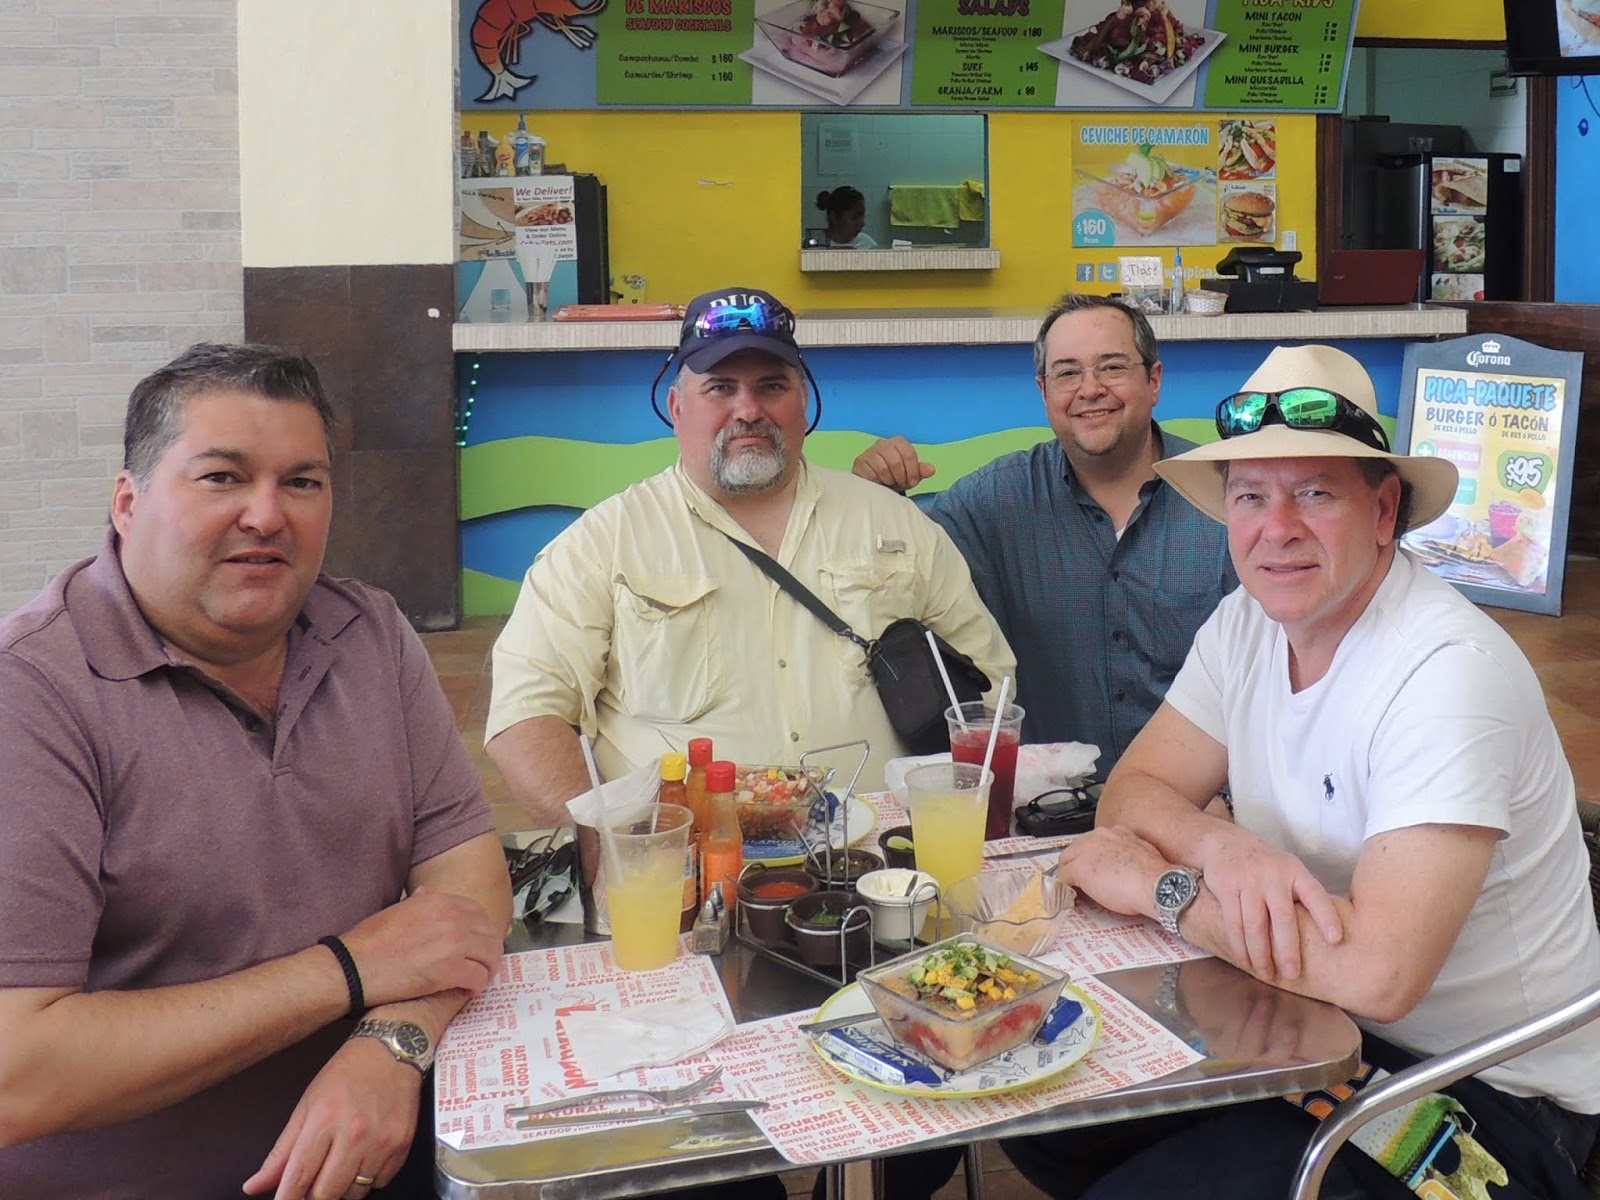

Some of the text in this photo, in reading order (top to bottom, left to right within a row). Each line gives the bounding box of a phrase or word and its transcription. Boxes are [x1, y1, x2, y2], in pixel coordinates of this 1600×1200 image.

[648, 0, 732, 15] MARISCOS
[957, 0, 1031, 16] SALADS
[1245, 12, 1268, 20] MINI
[625, 18, 732, 32] SEAFOOD COCKTAILS
[932, 26, 1018, 36] MARISCOS/SEAFOOD
[1239, 44, 1299, 54] MINI BURGER
[962, 62, 983, 71] SURF
[1224, 75, 1304, 85] MINI QUESADILLA
[938, 86, 1003, 96] GRANJA/FARM
[1081, 124, 1209, 145] CEVICHE DE CAMARÓN
[516, 188, 532, 197] We
[534, 186, 573, 196] Deliver!
[1076, 218, 1106, 236] $160
[1128, 264, 1159, 277] Tips!
[1466, 350, 1511, 367] Corona
[1424, 376, 1557, 412] PICA-PAQUETE
[1426, 407, 1484, 426] BURGER
[1502, 414, 1549, 431] TACÓN
[1434, 424, 1441, 432] DE
[1458, 426, 1478, 435] POLLO
[1527, 433, 1547, 441] POLLO
[1505, 456, 1544, 487] $95
[716, 1054, 736, 1062] FEEL
[762, 1042, 798, 1055] MOTION
[722, 1042, 760, 1054] FRENZY
[500, 1048, 515, 1087] GOURMET
[515, 1045, 529, 1087] FAST FOOD
[732, 1065, 769, 1077] WRAPS
[752, 1065, 811, 1083] QUESADILLAS
[1082, 1055, 1127, 1088] HEALTH
[439, 1087, 528, 1106] HEALTHY
[753, 1090, 836, 1115] FAST FOOD
[768, 1109, 844, 1133] GOURMET
[843, 1100, 881, 1135] HEALTHY
[899, 1100, 938, 1135] NATURAL
[775, 1117, 848, 1139] PICAMEMBER
[819, 1123, 857, 1136] FRESCO
[814, 1139, 856, 1152] FRENZY
